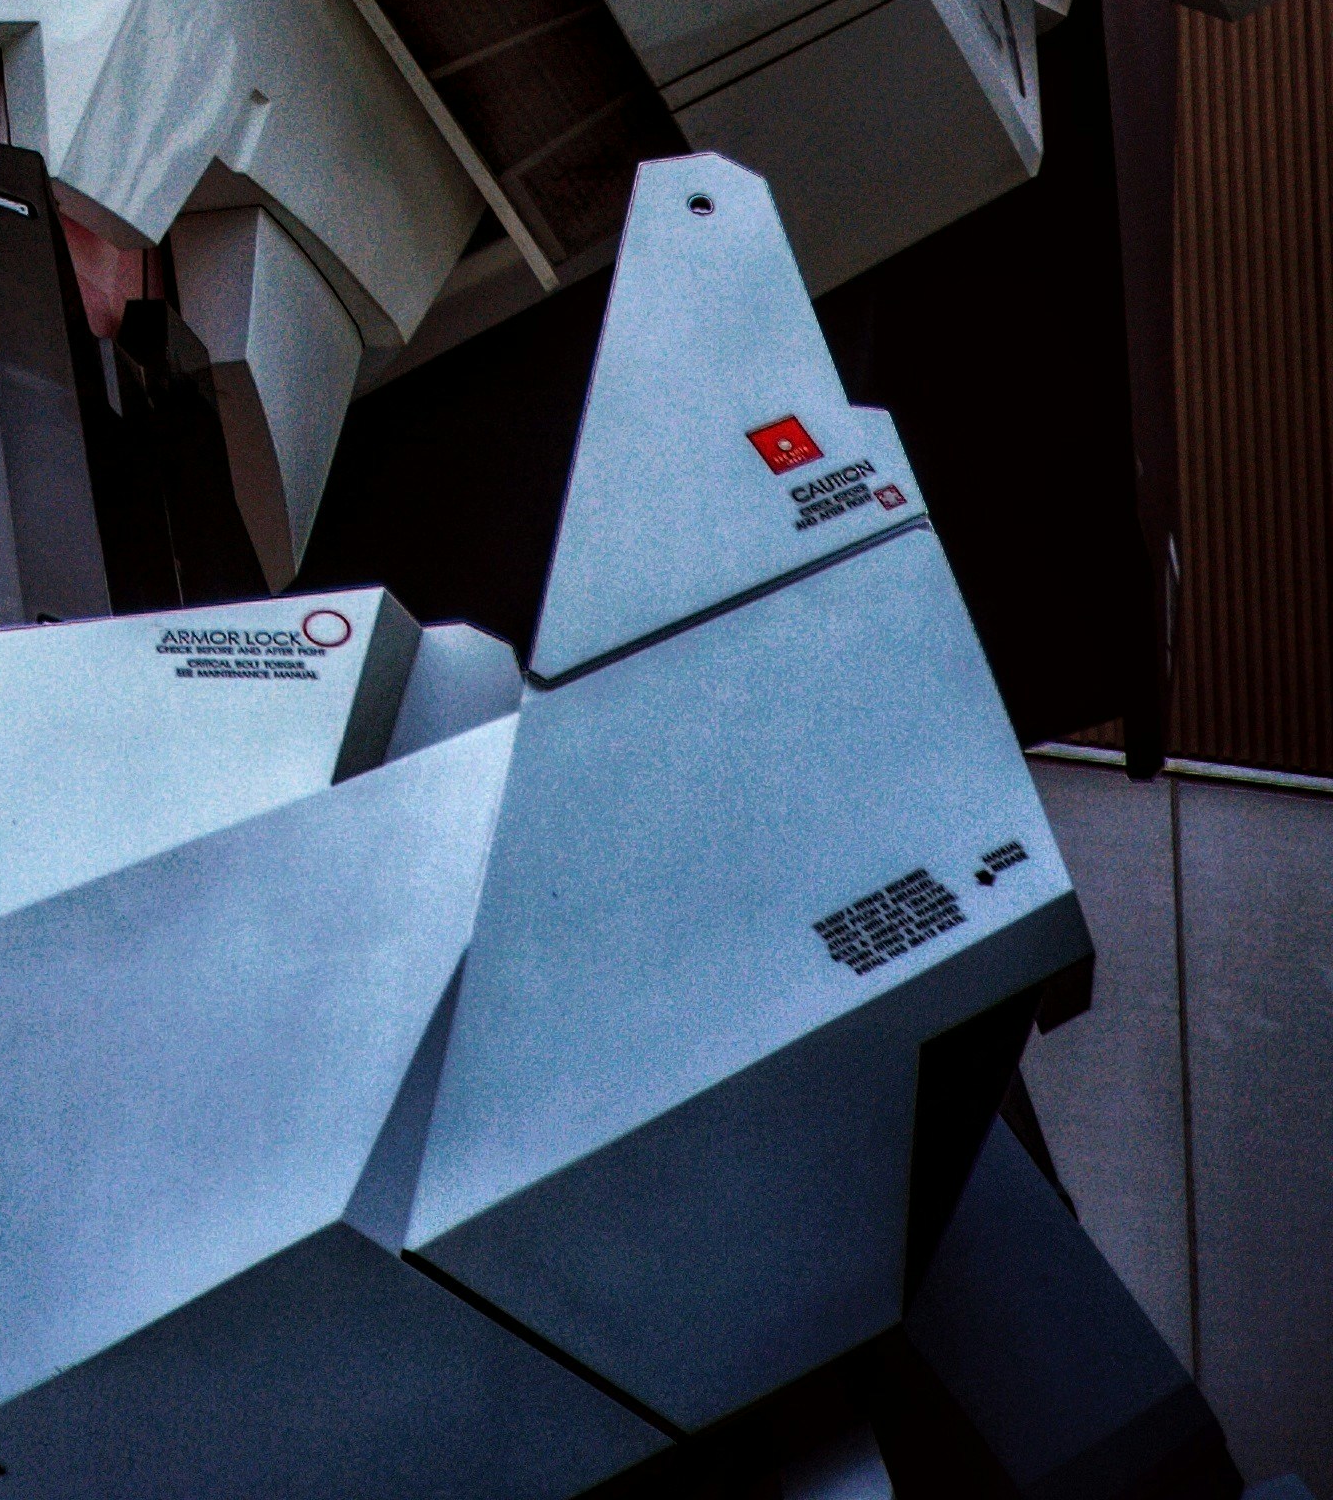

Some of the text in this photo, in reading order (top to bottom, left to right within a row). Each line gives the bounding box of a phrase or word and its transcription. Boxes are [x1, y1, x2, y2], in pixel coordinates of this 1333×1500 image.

[791, 459, 876, 503] CAUTION
[162, 630, 303, 646] ARMOR LOCK
